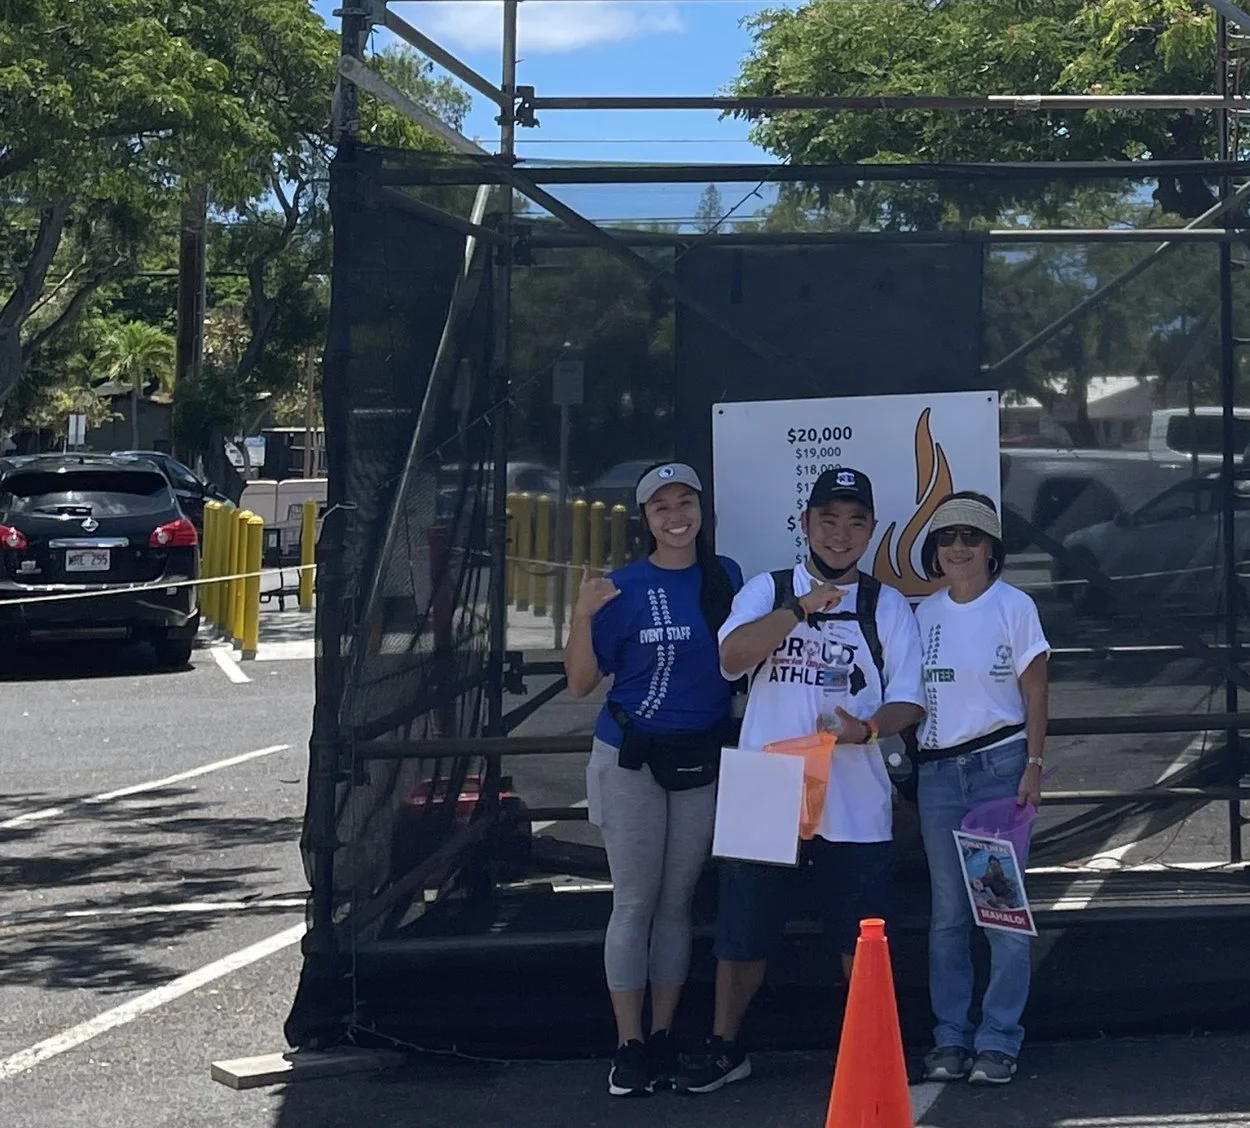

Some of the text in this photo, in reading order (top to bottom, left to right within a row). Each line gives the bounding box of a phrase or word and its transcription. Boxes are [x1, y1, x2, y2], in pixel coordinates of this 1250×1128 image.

[787, 426, 853, 445] $20,000
[795, 446, 842, 460] $19,000
[640, 625, 691, 644] EVENT STAFF
[768, 665, 825, 687] ATHLE
